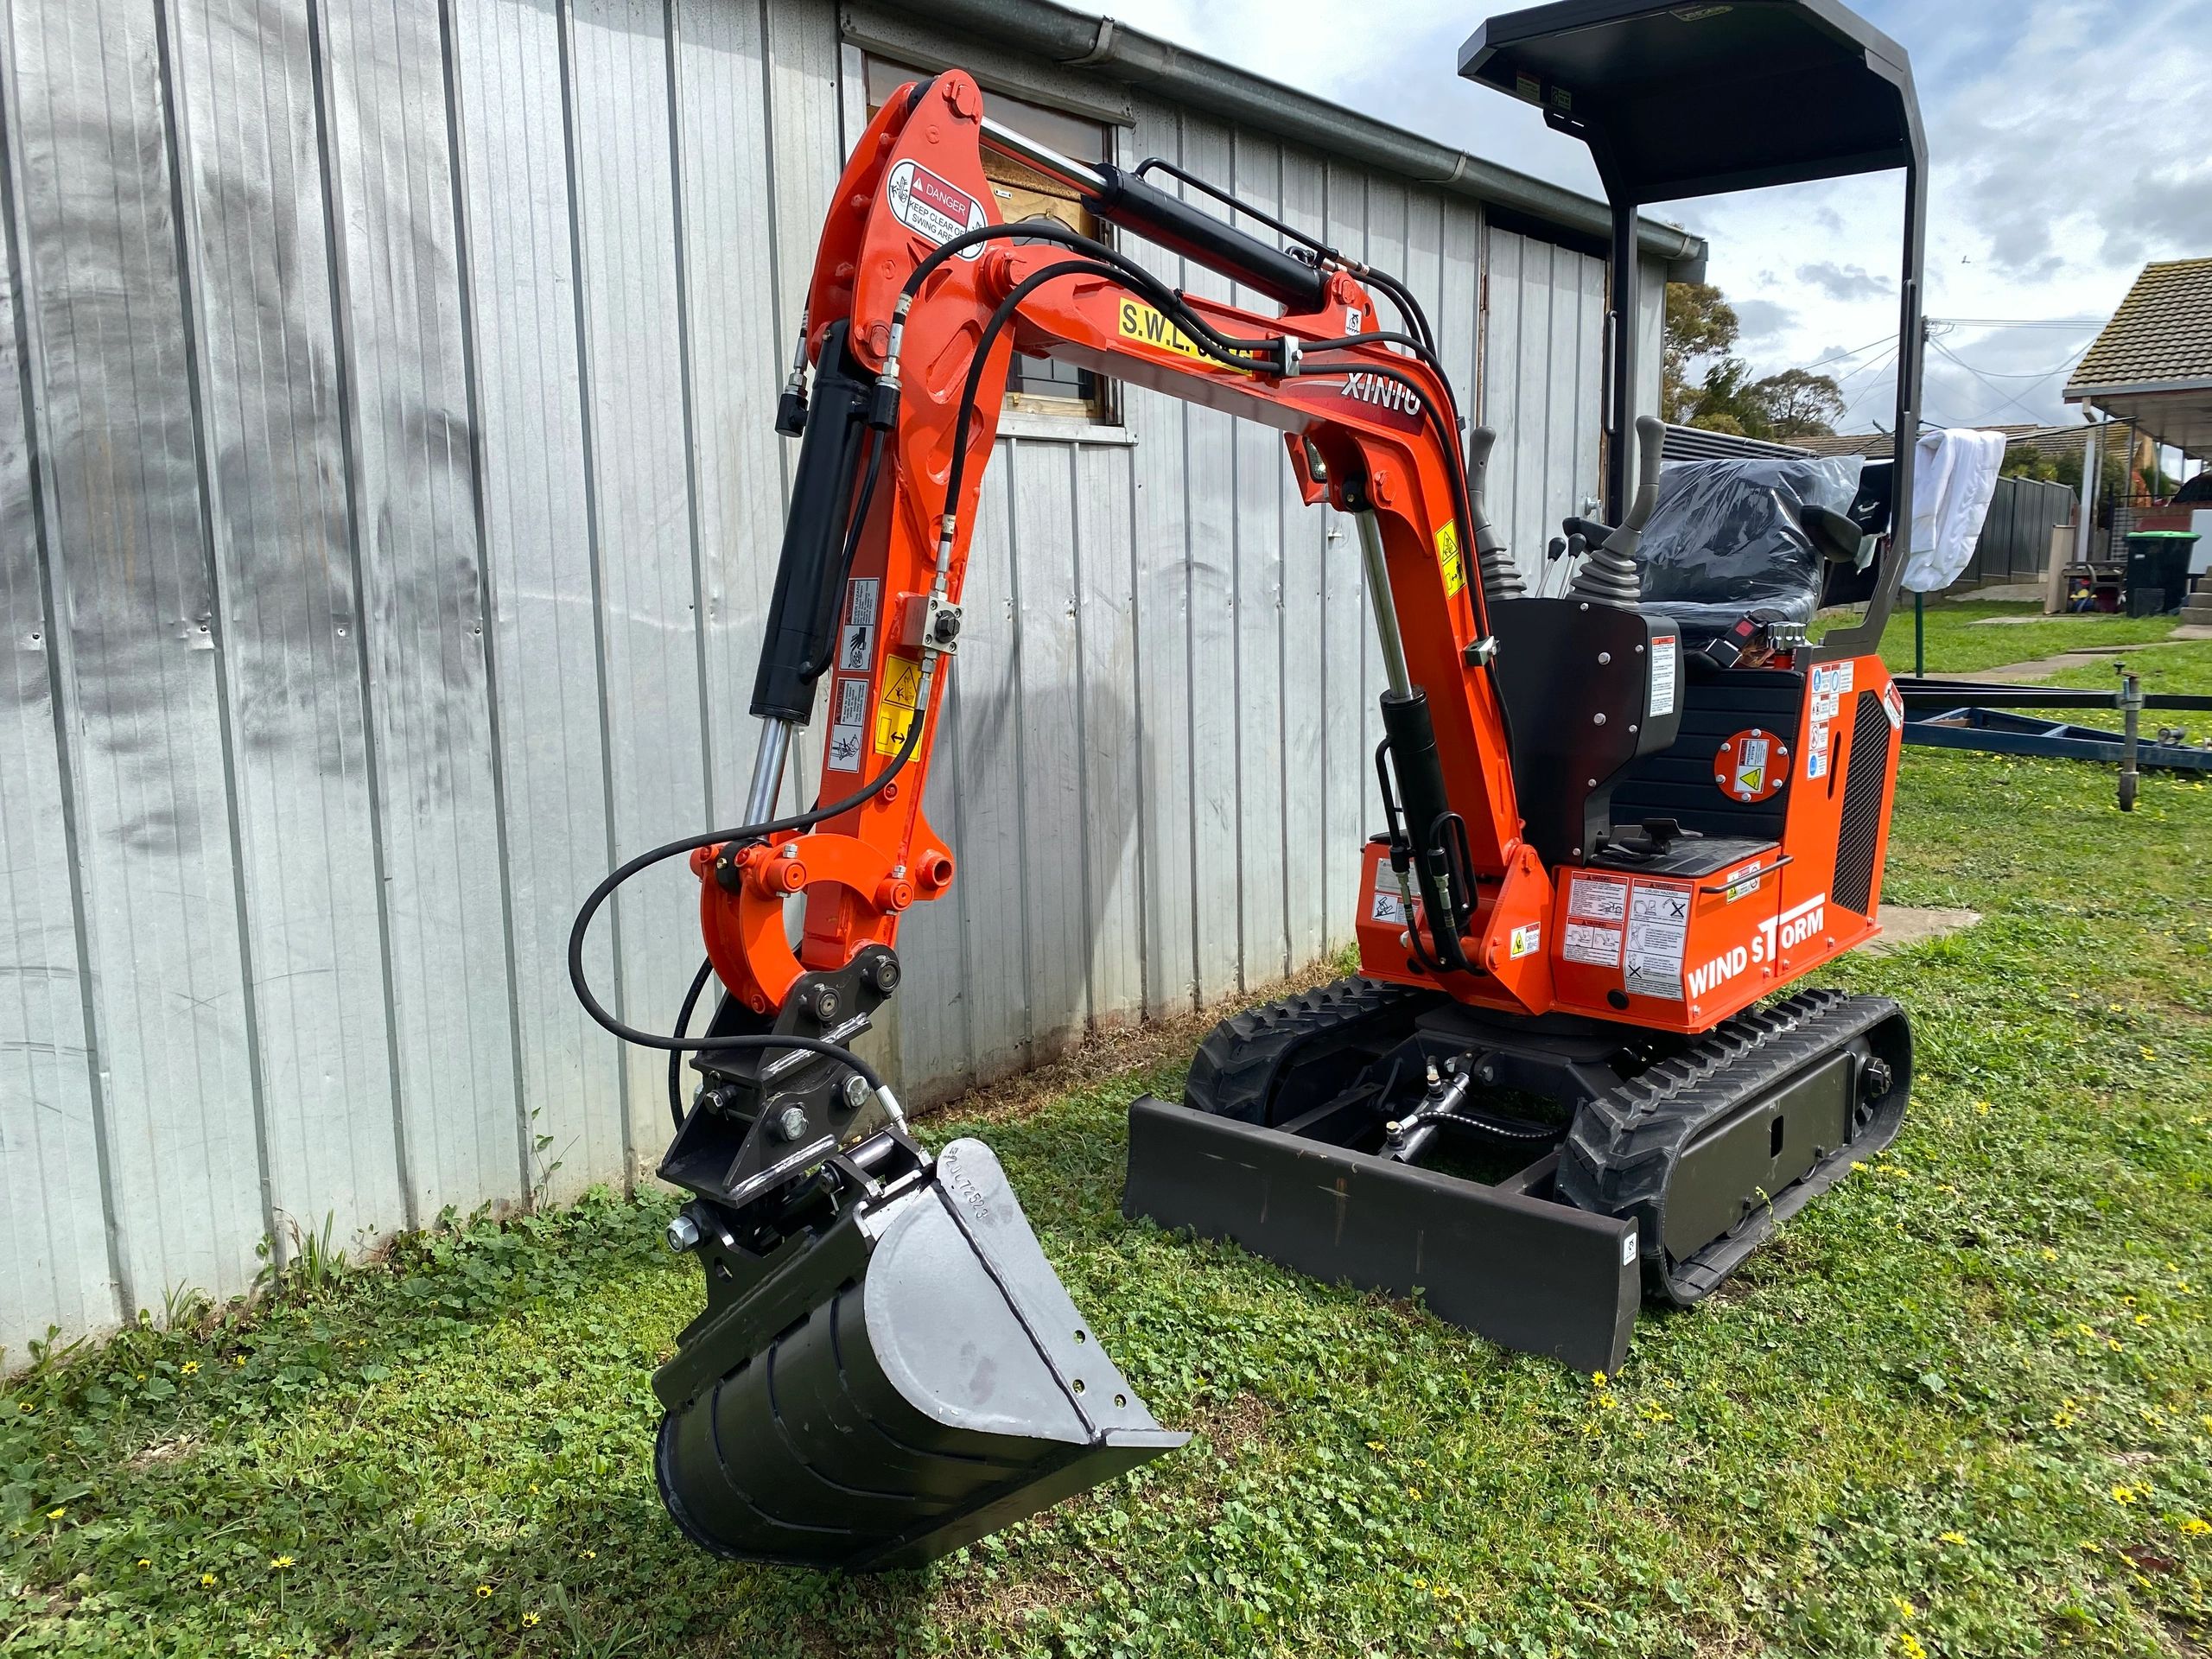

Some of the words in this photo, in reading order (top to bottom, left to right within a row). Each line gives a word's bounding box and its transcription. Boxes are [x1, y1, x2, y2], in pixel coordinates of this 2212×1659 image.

[926, 183, 966, 216] DANGER
[908, 200, 929, 217] KEEP
[930, 212, 954, 232] CLEAR
[912, 213, 937, 233] SWING
[937, 230, 957, 243] ARE
[1688, 945, 1747, 1000] WIND
[1751, 893, 1826, 963] STORM
